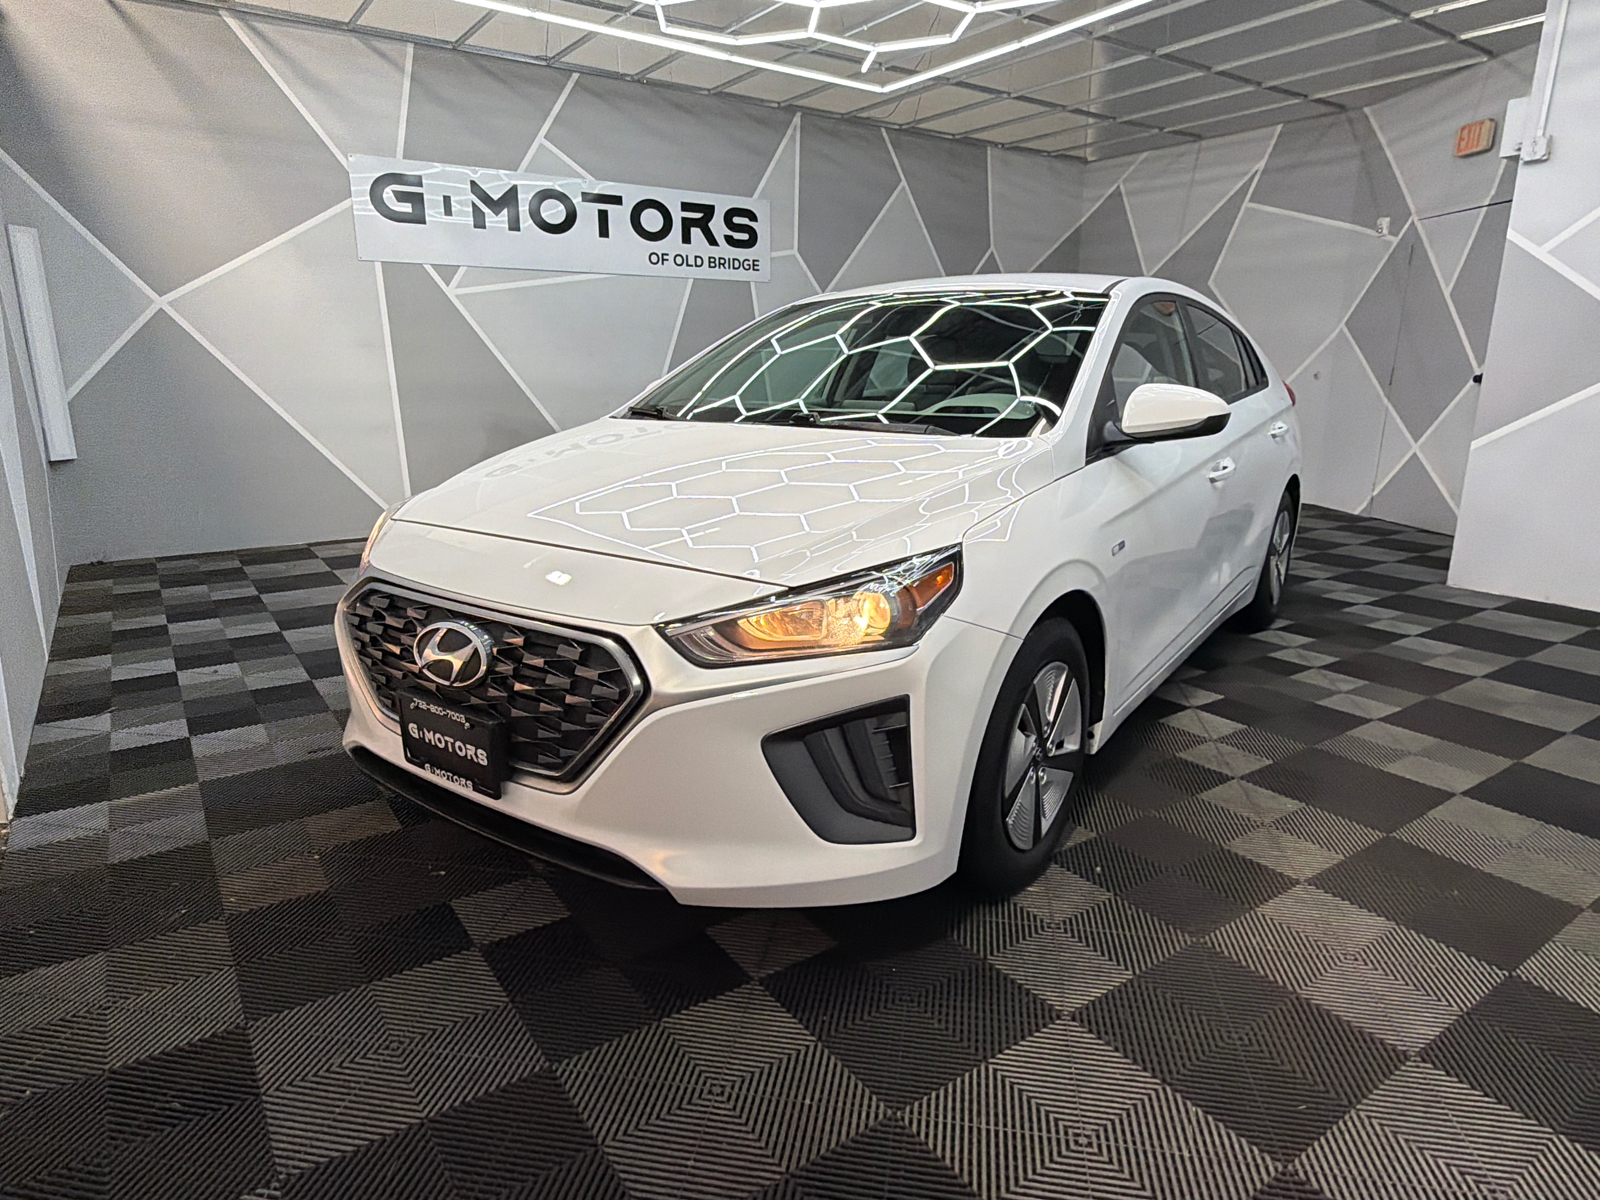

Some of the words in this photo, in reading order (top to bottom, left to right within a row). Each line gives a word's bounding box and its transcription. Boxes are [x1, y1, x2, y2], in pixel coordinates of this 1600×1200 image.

[648, 252, 669, 266] OF
[673, 254, 704, 268] OLD
[708, 256, 760, 271] BRIDGE
